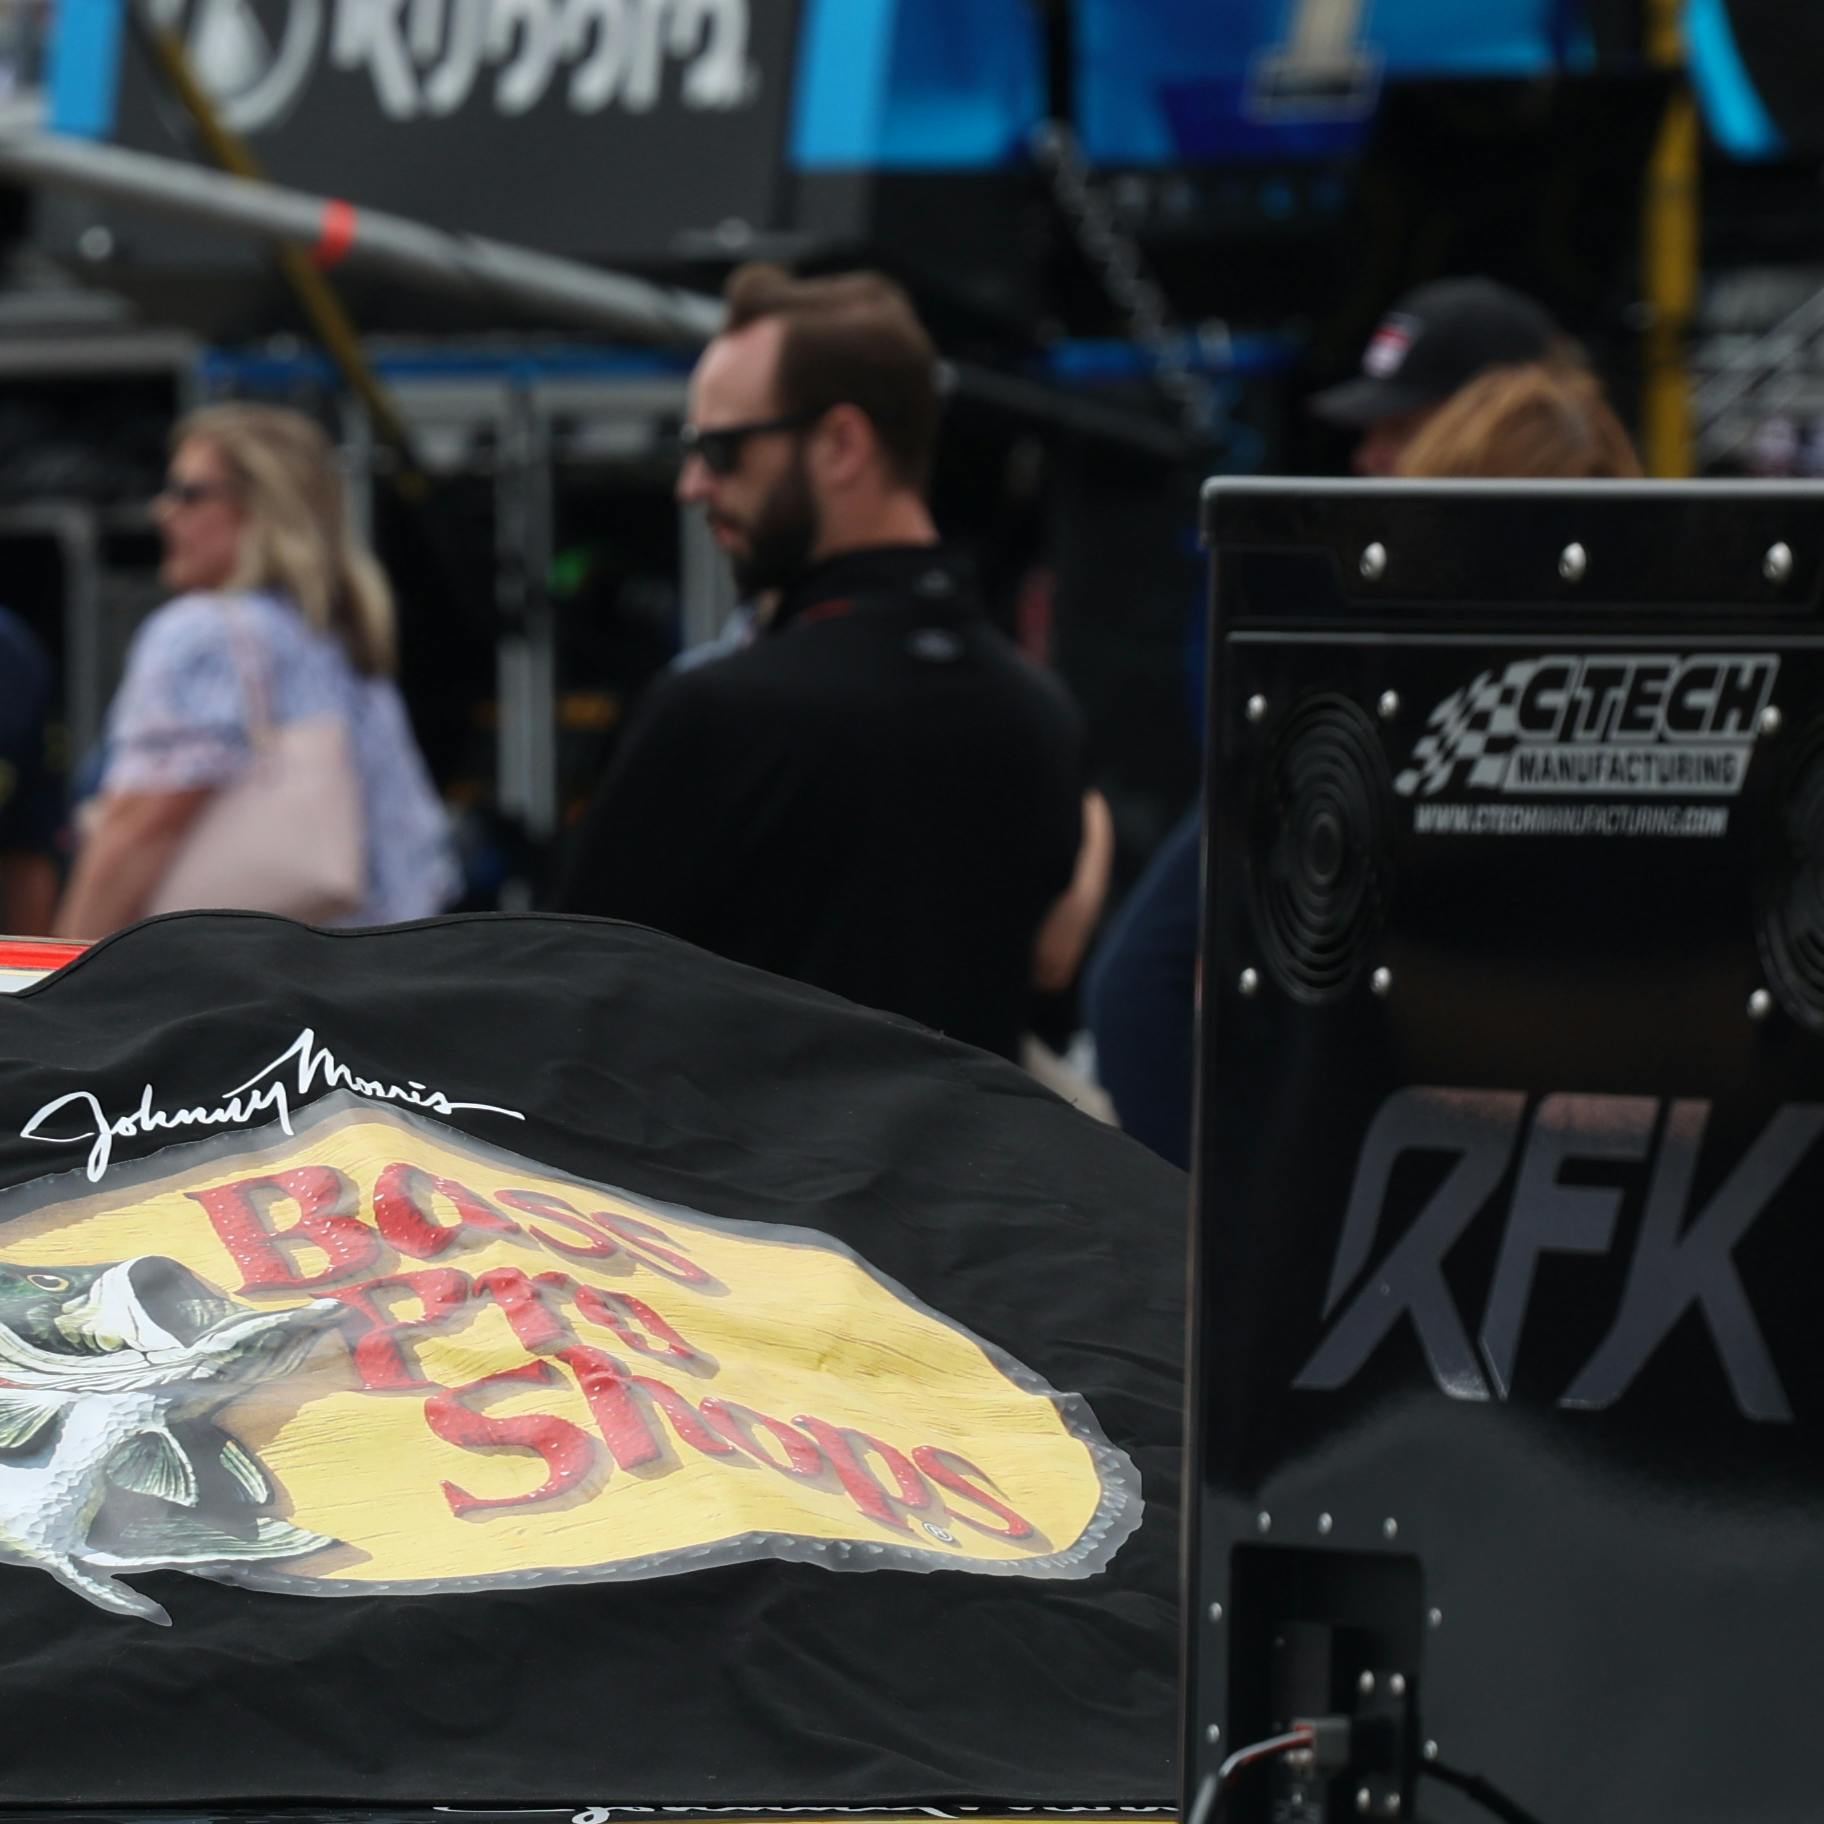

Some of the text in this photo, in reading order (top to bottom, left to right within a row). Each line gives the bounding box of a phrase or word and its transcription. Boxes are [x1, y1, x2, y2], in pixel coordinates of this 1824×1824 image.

[1517, 655, 1780, 742] CTECH
[1517, 751, 1738, 784] MANUFACTURING
[20, 1027, 525, 1182] Johnny Morris
[185, 1162, 733, 1300] Bass
[1291, 1085, 1824, 1423] RFK
[326, 1266, 719, 1394] Pro
[424, 1345, 1034, 1543] Shops
